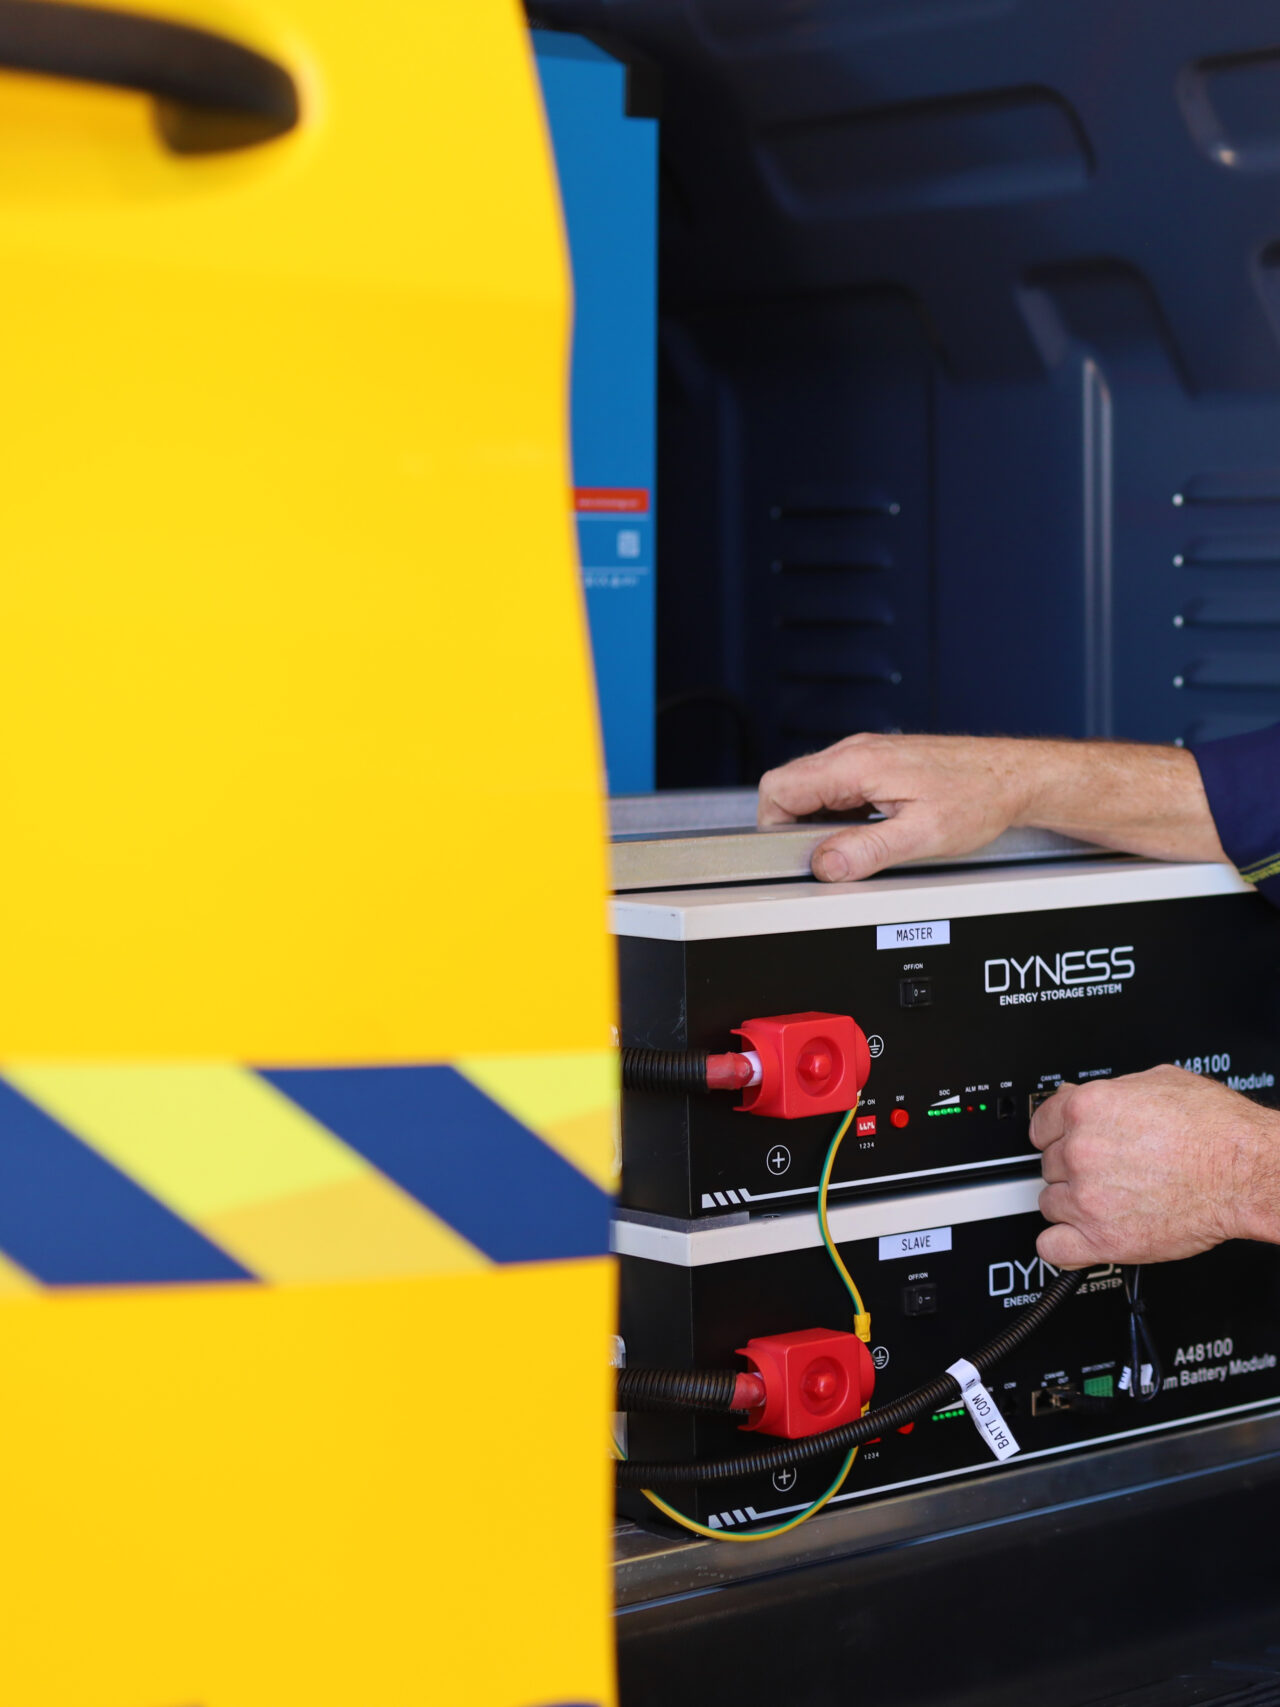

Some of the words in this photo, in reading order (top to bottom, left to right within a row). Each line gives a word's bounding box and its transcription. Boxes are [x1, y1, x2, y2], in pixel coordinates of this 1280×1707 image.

[896, 927, 933, 942] MASTER
[903, 962, 924, 971] OFF/ON
[984, 945, 1136, 993] DYNESS
[999, 992, 1038, 1006] ENERGY
[1040, 987, 1085, 1001] STORAGE
[1086, 983, 1122, 996] SYSTEM
[1227, 1072, 1275, 1091] Module
[901, 1235, 932, 1251] SLAVE
[1174, 1337, 1234, 1366] A48100
[1180, 1364, 1228, 1387] Battery
[1229, 1353, 1277, 1376] Module
[972, 1393, 991, 1417] COM
[984, 1419, 1010, 1449] BATT
